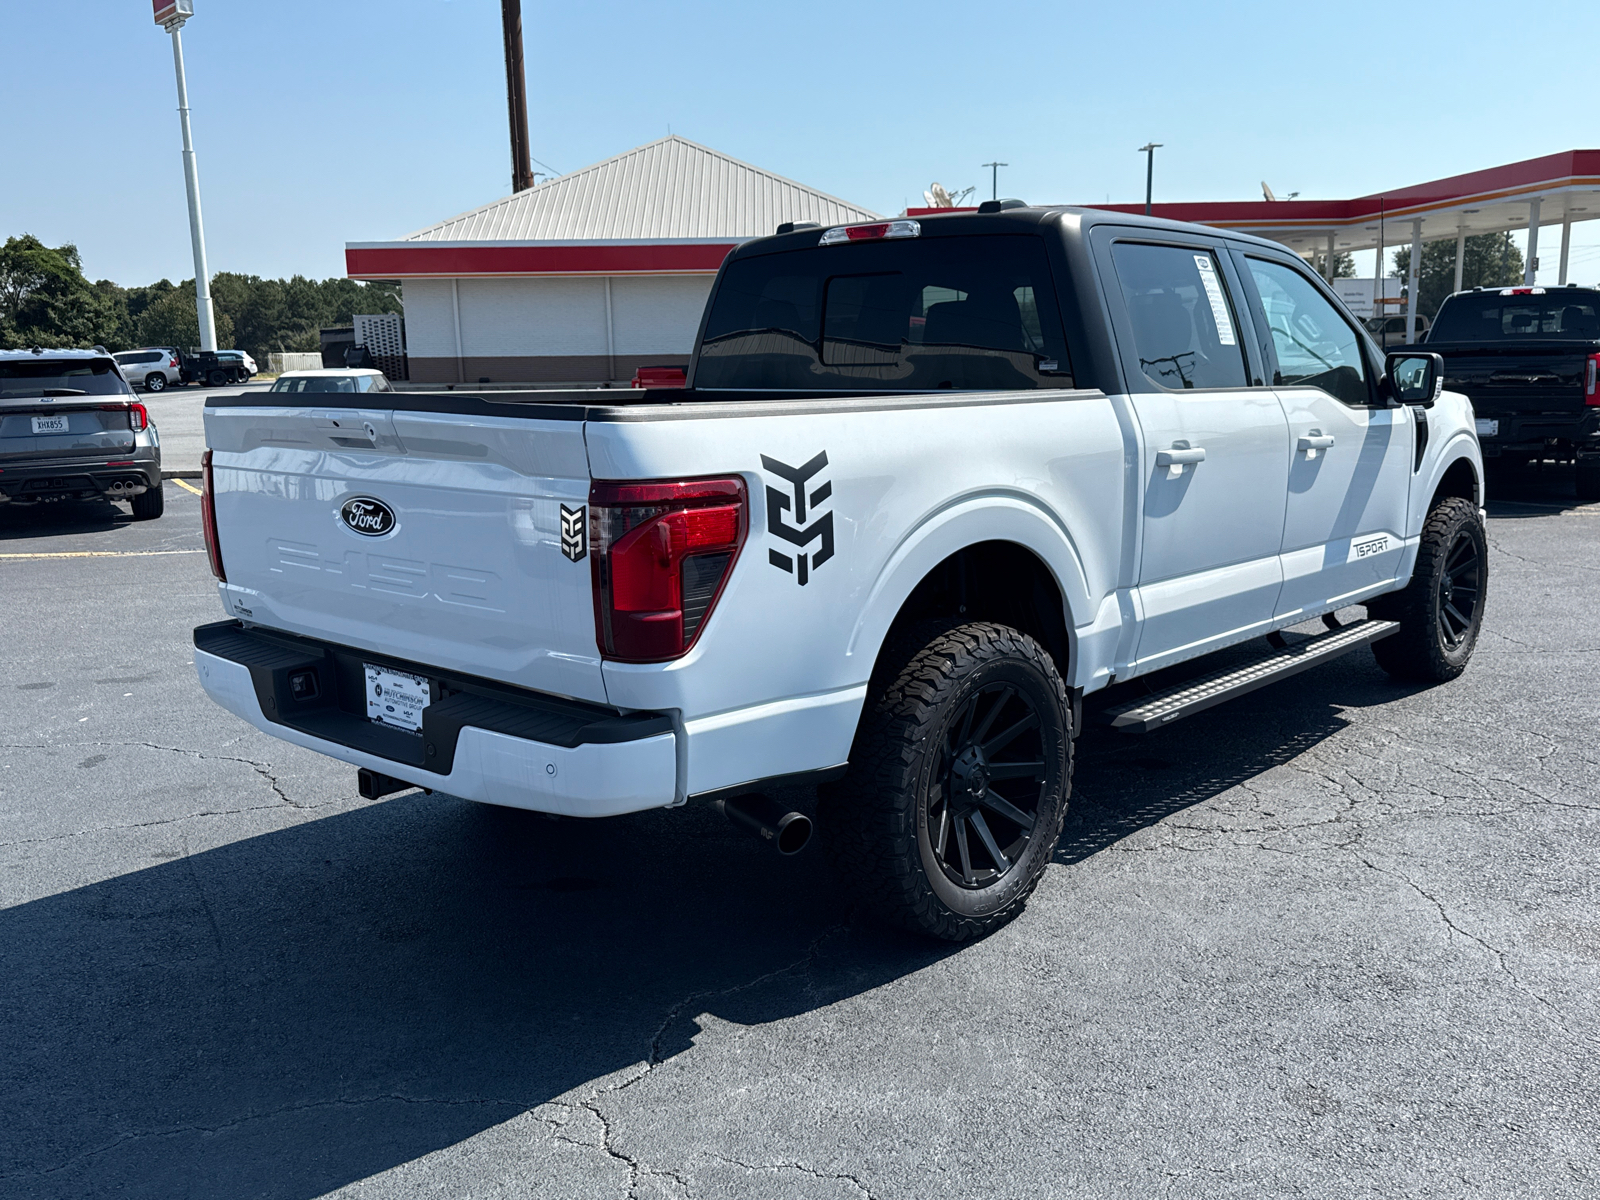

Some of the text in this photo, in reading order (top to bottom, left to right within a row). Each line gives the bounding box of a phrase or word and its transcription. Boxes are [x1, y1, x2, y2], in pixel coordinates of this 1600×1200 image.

[37, 420, 63, 429] XHX855
[349, 502, 383, 530] Ford
[384, 688, 423, 705] HUTCHINSON
